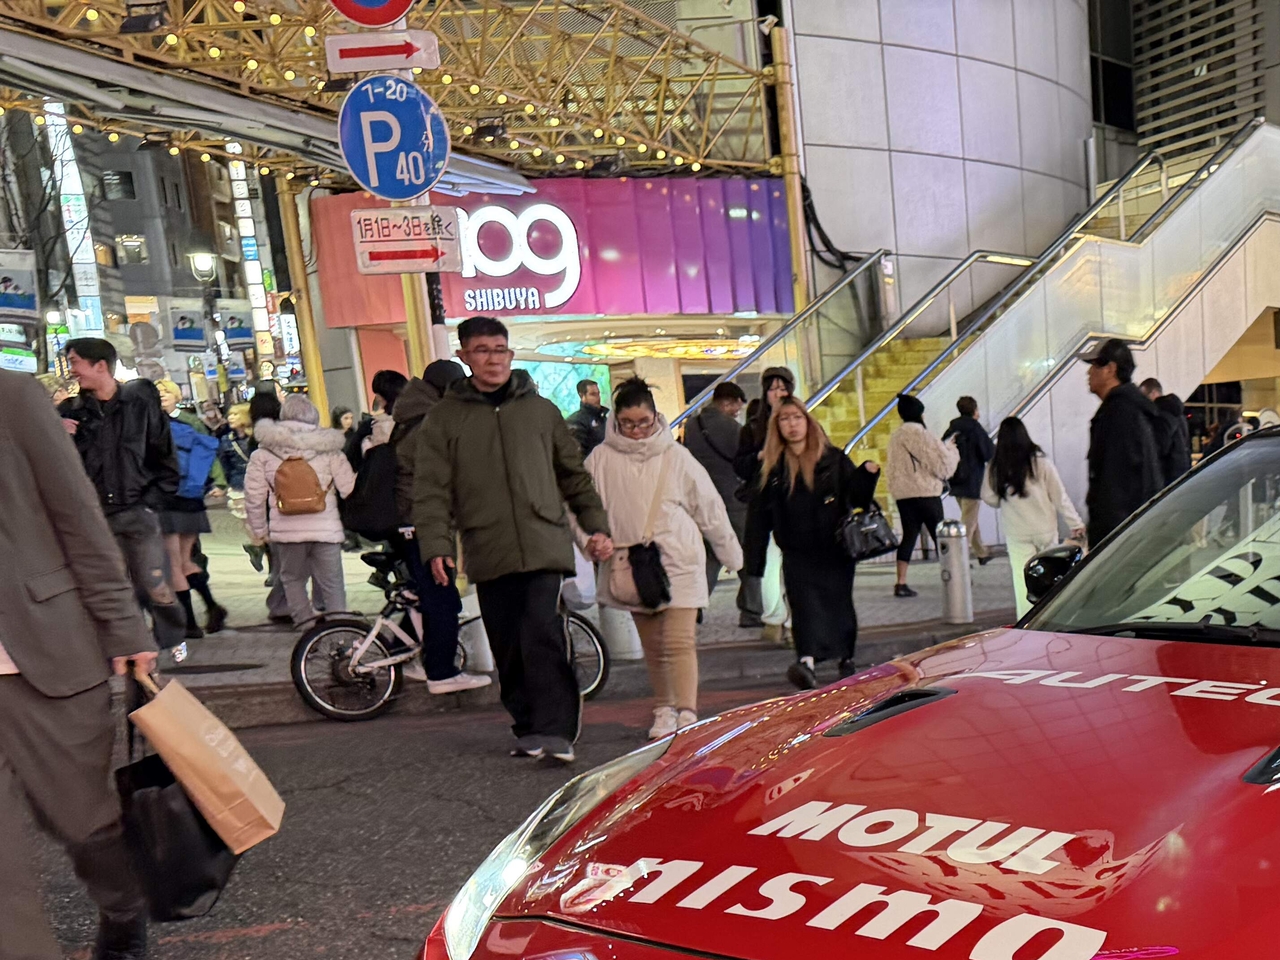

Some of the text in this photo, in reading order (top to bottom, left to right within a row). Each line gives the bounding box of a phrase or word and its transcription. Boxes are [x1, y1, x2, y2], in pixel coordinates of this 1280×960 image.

[360, 110, 402, 188] P
[396, 151, 426, 187] 40
[463, 286, 541, 312] SHIBUYA
[747, 800, 1077, 875] MOTUL
